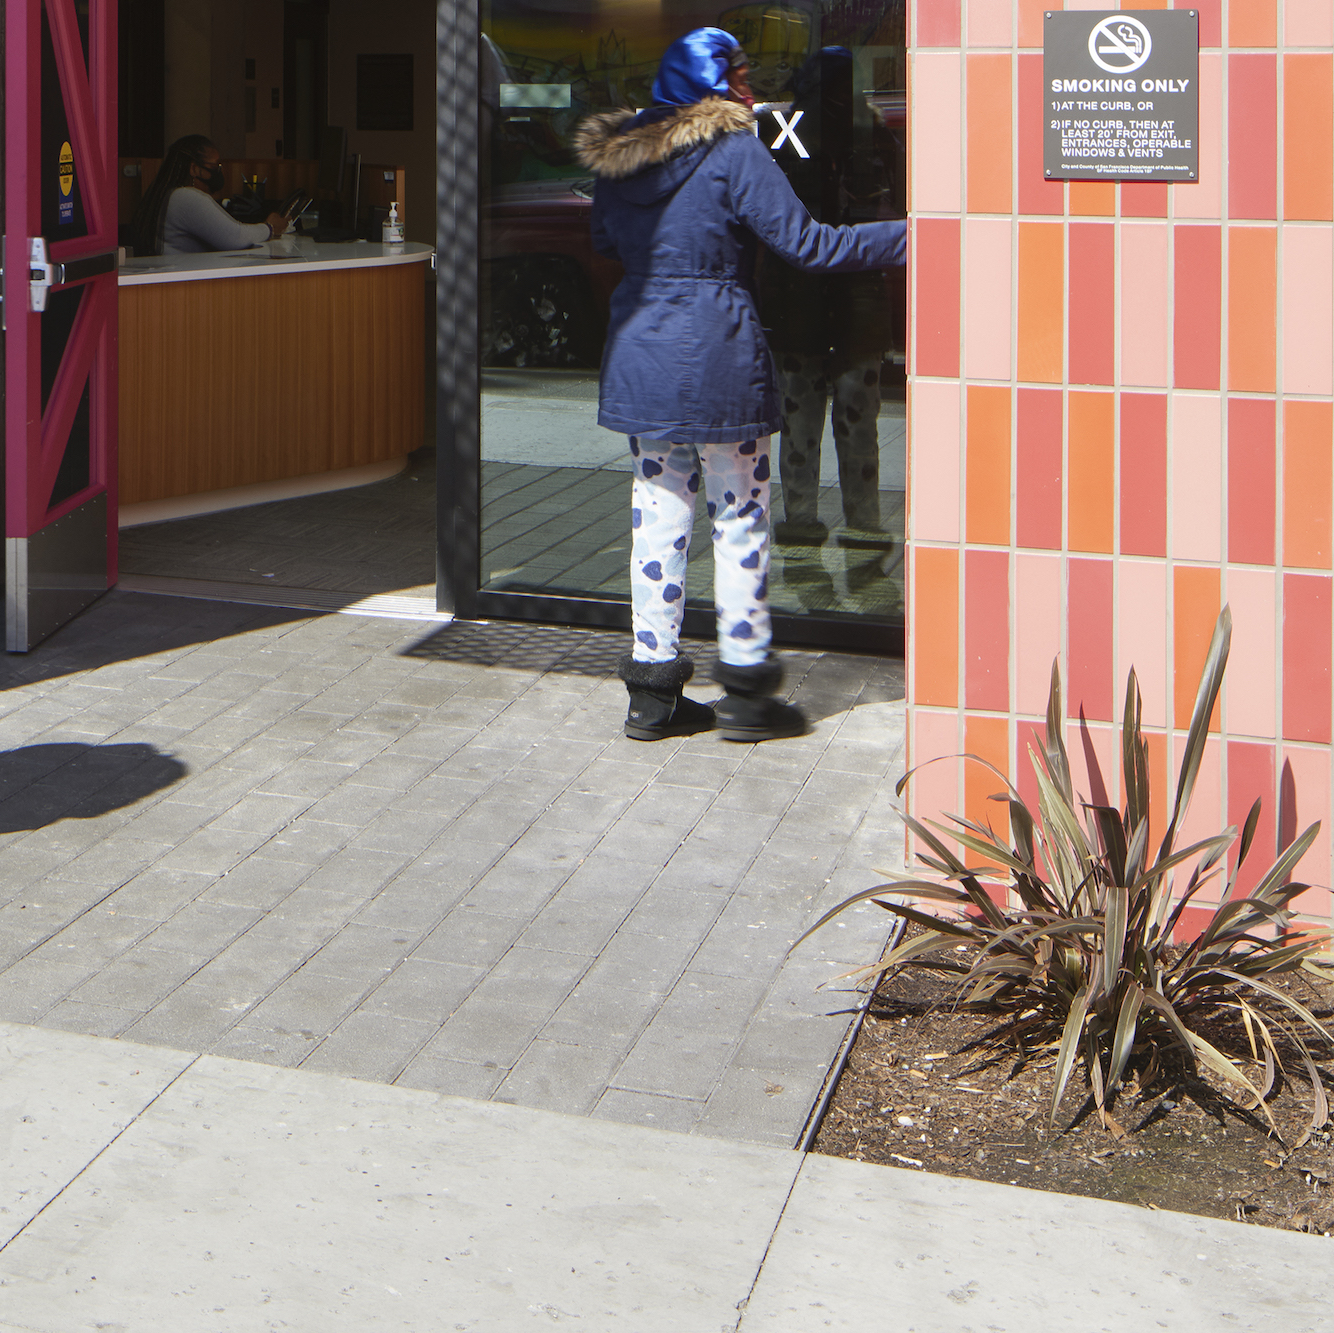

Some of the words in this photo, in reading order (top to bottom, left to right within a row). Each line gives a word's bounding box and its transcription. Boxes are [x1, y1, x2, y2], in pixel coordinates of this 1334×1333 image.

[1051, 79, 1137, 93] SMOKING
[1141, 79, 1190, 93] ONLY
[1076, 101, 1099, 111] THE
[1100, 101, 1135, 112] CURB,
[1137, 101, 1154, 111] OR
[1074, 120, 1091, 129] NO
[1092, 120, 1127, 130] CURB,
[1129, 120, 1159, 130] THEN
[1161, 120, 1175, 130] AT
[1061, 129, 1096, 138] LEAST
[1097, 129, 1114, 138] 20'
[1116, 130, 1148, 139] FROM
[1150, 130, 1177, 139] EXIT,
[1061, 139, 1130, 149] ENTRANCES,
[1132, 139, 1192, 149] OPERABLE
[1061, 148, 1116, 157] WINDOWS
[1117, 148, 1126, 157] &
[1127, 148, 1164, 158] VENTS
